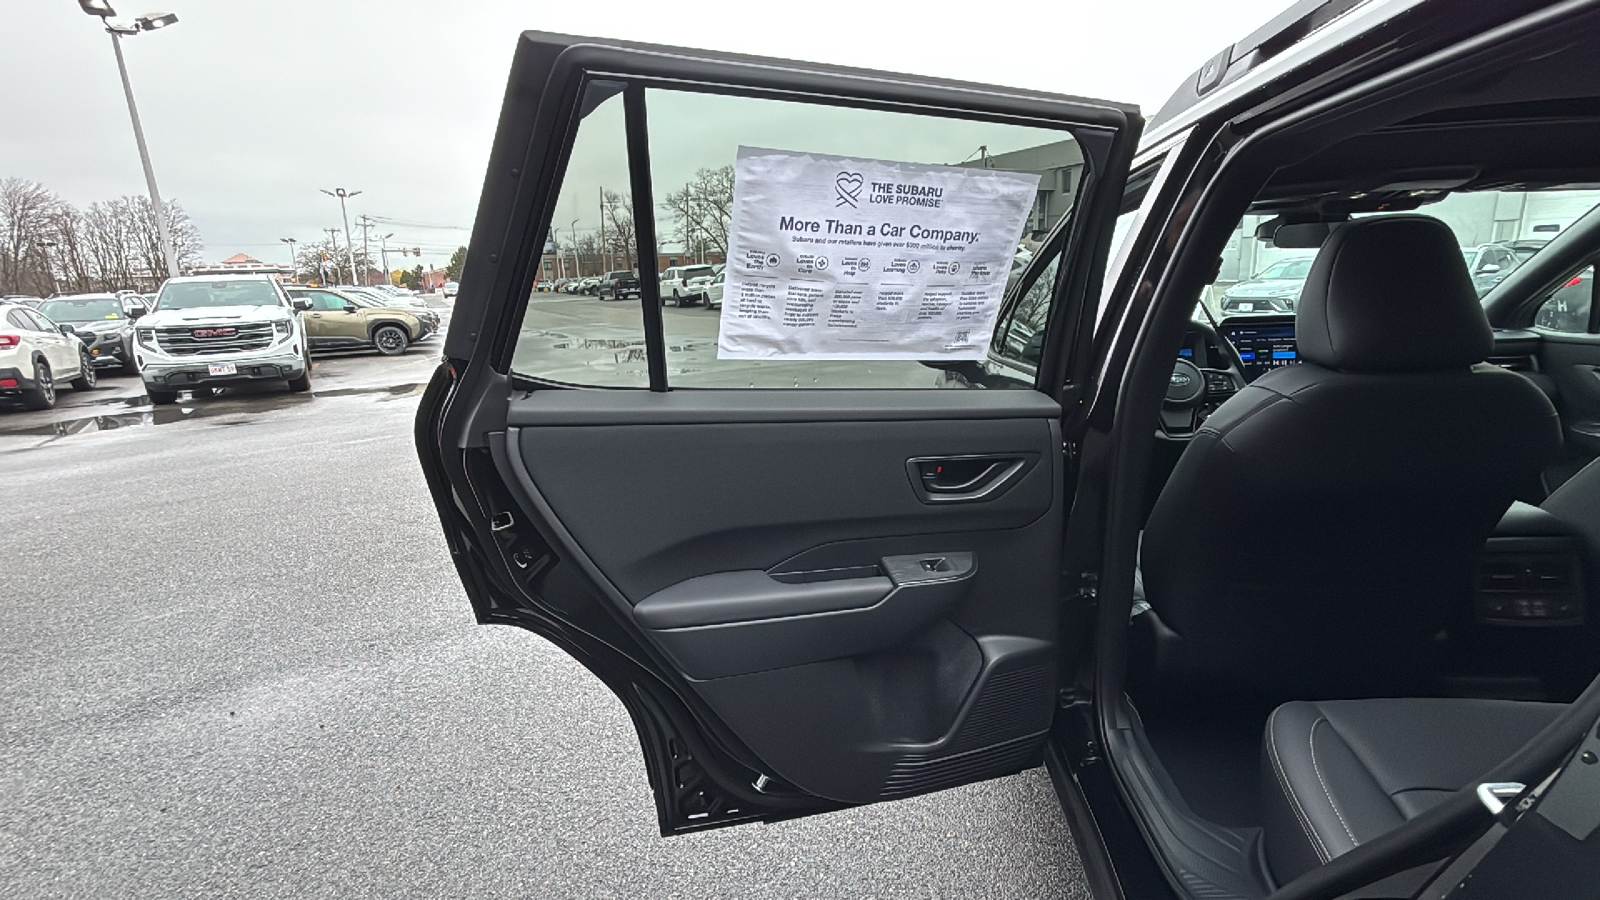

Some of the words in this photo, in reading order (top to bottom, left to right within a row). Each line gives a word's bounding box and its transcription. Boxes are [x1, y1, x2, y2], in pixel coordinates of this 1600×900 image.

[870, 182, 894, 195] THE
[895, 184, 943, 198] SUBARU
[869, 194, 895, 205] LOVE
[895, 196, 941, 209] PROMISE
[779, 216, 821, 233] More
[824, 219, 863, 236] Than
[866, 224, 876, 236] a
[879, 222, 907, 239] Car
[791, 235, 815, 244] Subaru
[815, 237, 827, 245] and
[862, 240, 877, 248] have
[877, 241, 892, 249] given
[746, 252, 765, 260] Loves
[746, 263, 764, 271] Earth
[194, 328, 236, 337] GMC
